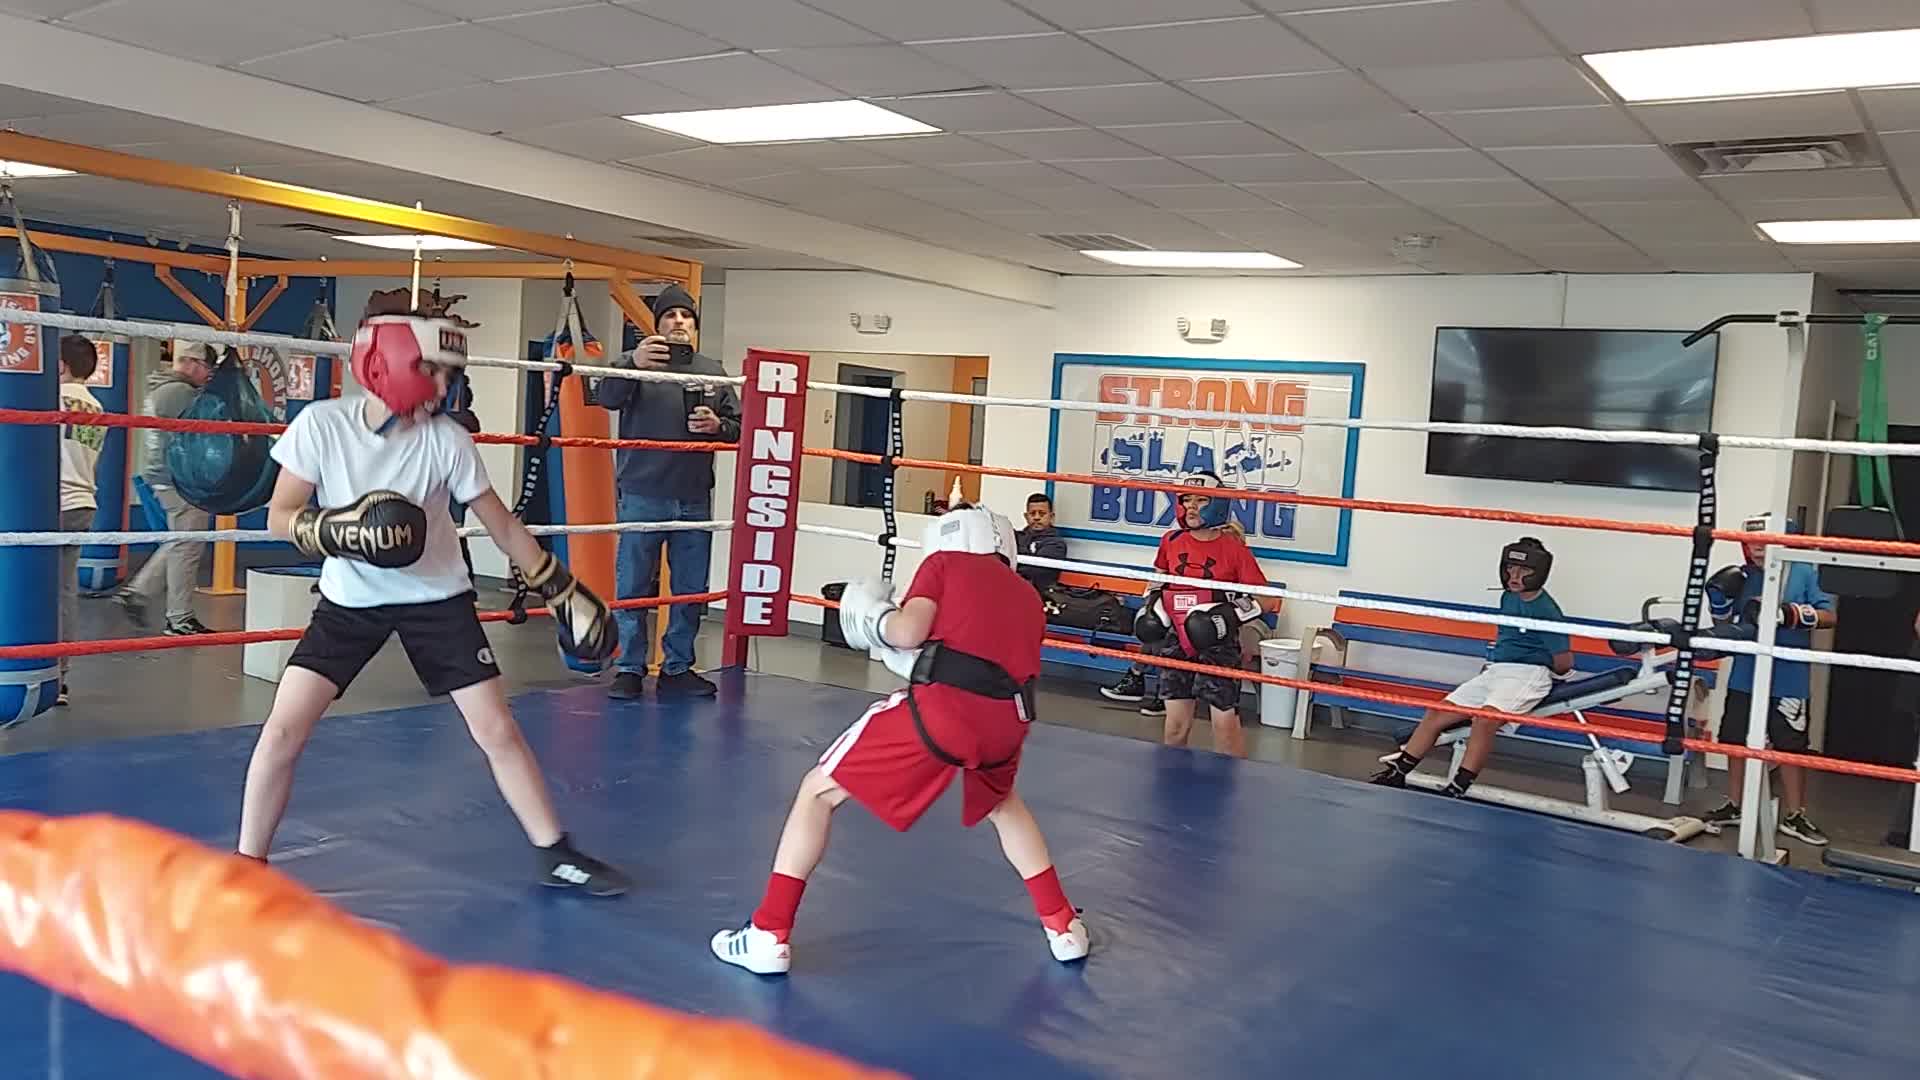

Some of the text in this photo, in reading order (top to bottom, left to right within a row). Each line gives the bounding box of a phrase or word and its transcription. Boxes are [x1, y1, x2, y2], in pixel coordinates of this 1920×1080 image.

[1097, 374, 1308, 434] STRONG
[1092, 423, 1305, 489] ISLAND
[740, 360, 799, 625] RINGSIDE
[1090, 475, 1299, 541] BOXNG
[330, 524, 413, 560] VENUM
